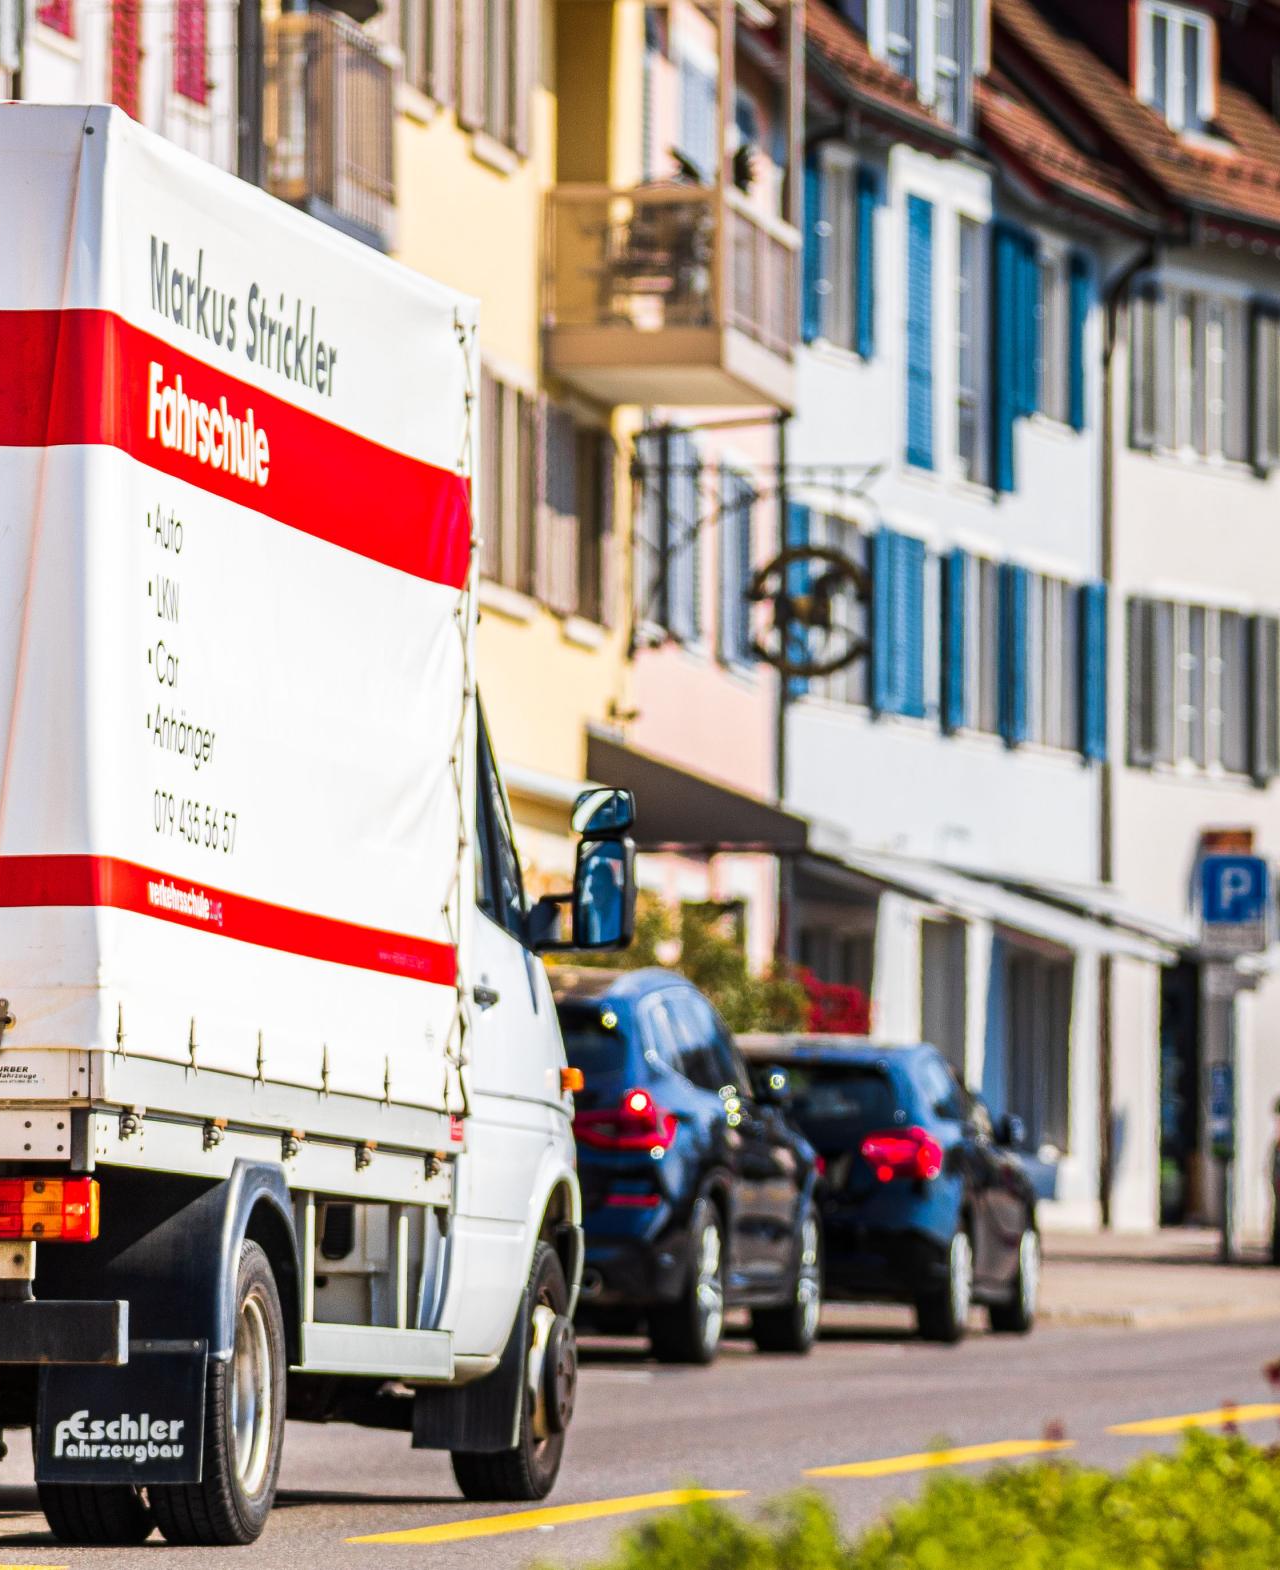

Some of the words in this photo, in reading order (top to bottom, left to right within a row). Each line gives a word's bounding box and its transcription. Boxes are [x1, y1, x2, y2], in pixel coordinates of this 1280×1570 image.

[149, 233, 237, 352] Markus
[246, 281, 337, 398] Strickler
[147, 359, 271, 487] Fahrschule
[155, 503, 183, 554] Auto
[156, 573, 180, 624] LKW
[155, 639, 180, 688] Car
[154, 703, 215, 771] Anhänger
[154, 788, 175, 836] 079
[179, 799, 200, 845] 435
[204, 805, 219, 850] 56
[222, 811, 237, 854] 57
[1220, 867, 1252, 910] P
[69, 1410, 185, 1441] Eschler
